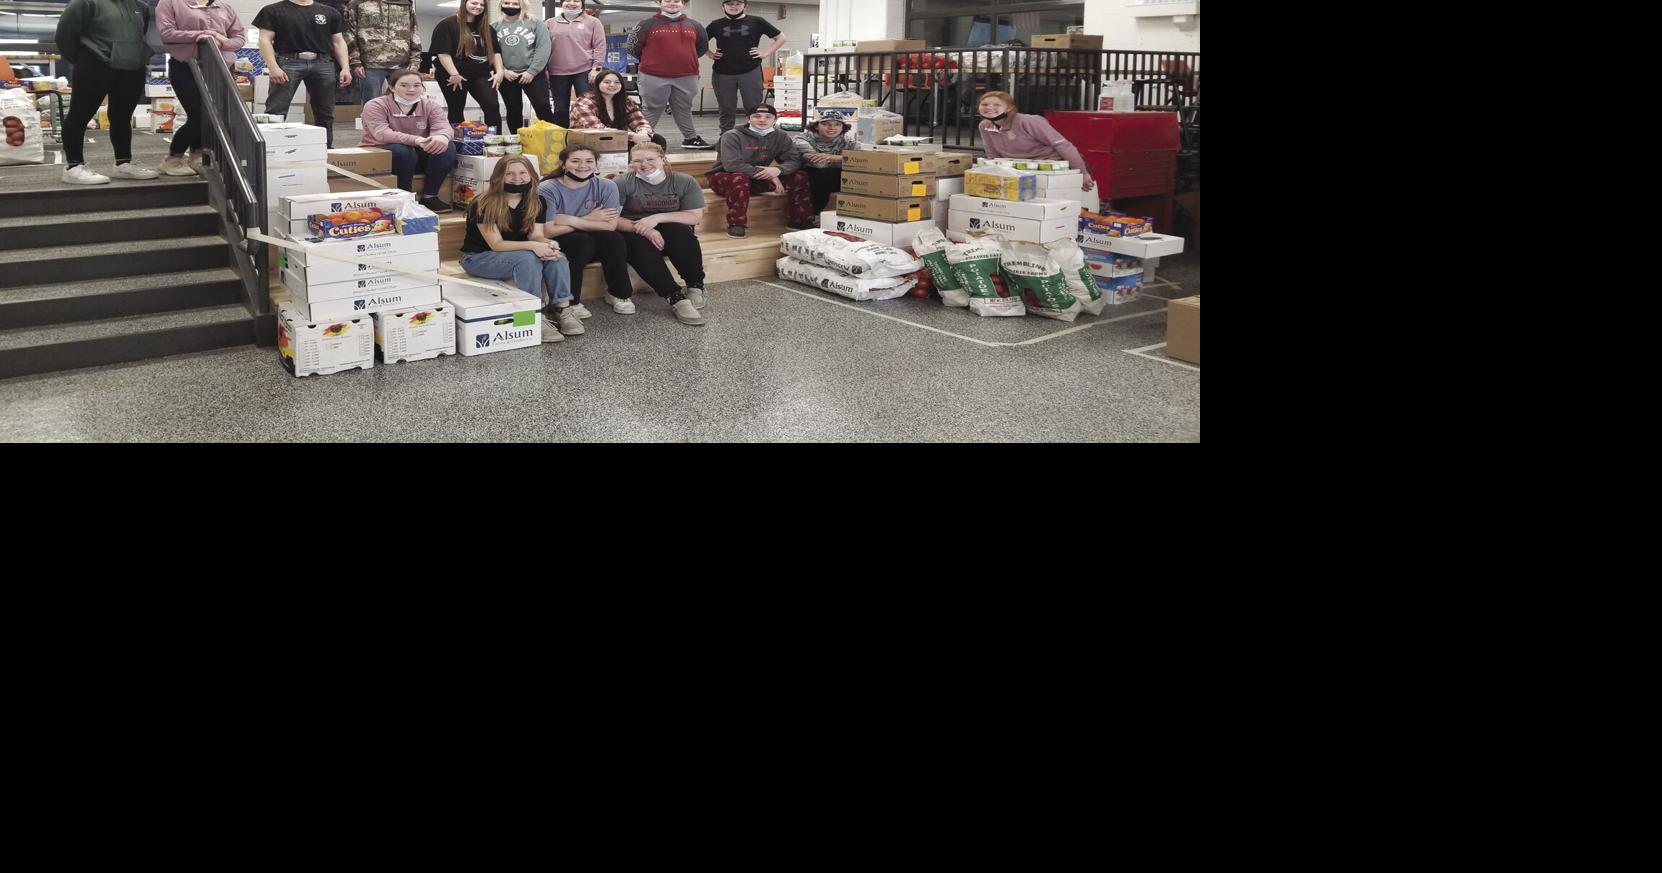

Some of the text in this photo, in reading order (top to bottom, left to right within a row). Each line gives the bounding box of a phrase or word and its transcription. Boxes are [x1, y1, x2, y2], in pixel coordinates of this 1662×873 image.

[344, 201, 377, 209] Alsum
[329, 223, 372, 237] Cuties
[846, 223, 873, 235] Alsum
[982, 220, 1016, 231] Alsum
[367, 241, 391, 250] Alsum
[1085, 236, 1112, 247] Alsum
[367, 277, 392, 286] Alsum
[829, 281, 854, 294] Alsum
[368, 296, 402, 307] Alsum
[493, 329, 533, 342] Alsum
